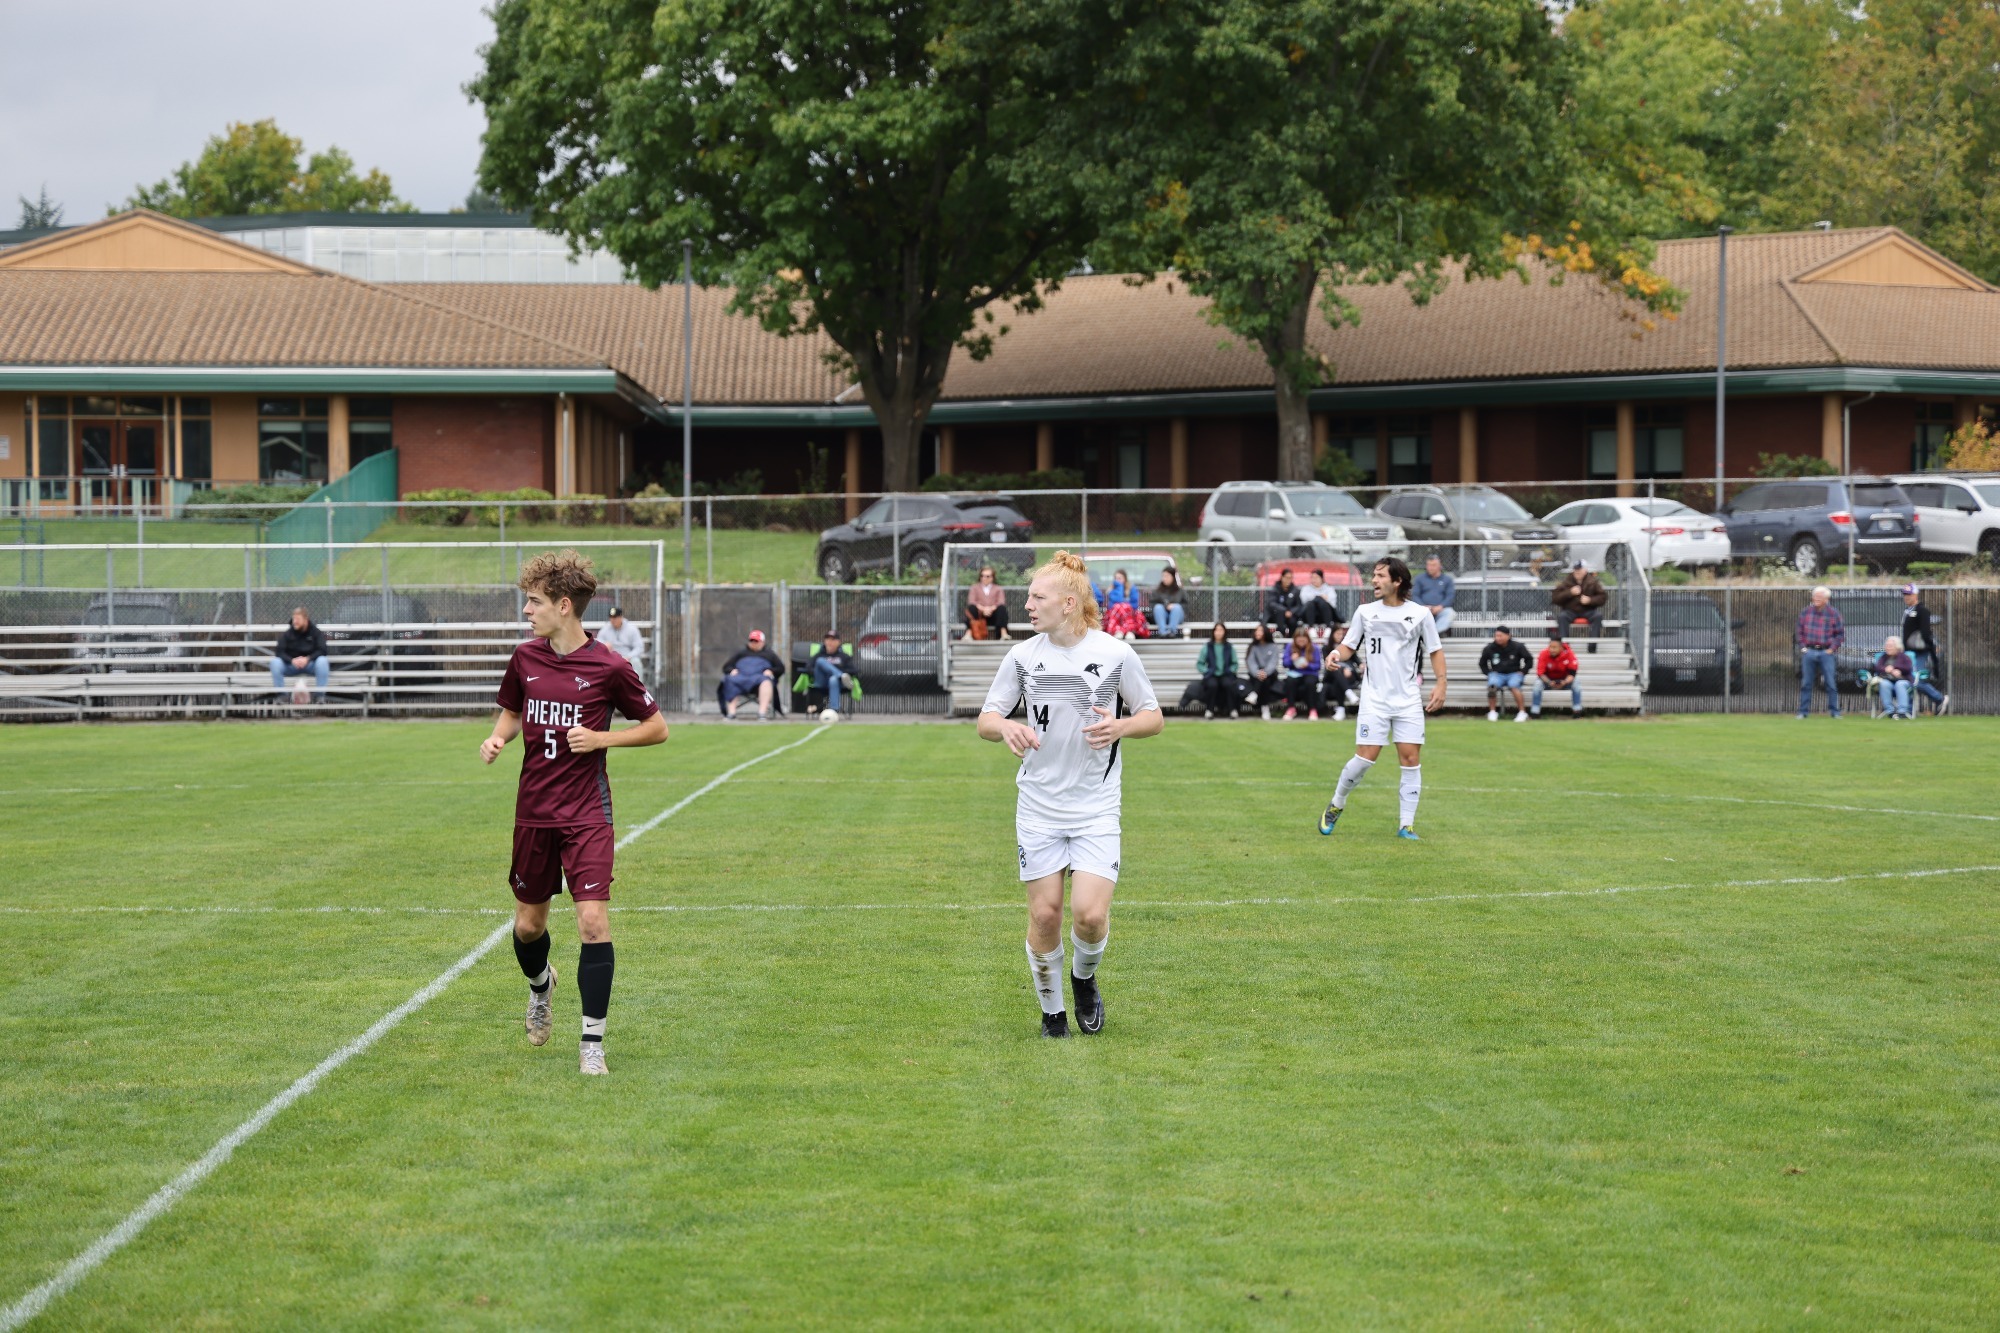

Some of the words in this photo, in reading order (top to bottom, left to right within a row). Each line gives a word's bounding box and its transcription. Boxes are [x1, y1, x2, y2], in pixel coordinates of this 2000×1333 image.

[1370, 637, 1382, 654] 31
[526, 698, 584, 727] PIERCE
[544, 729, 557, 760] 5
